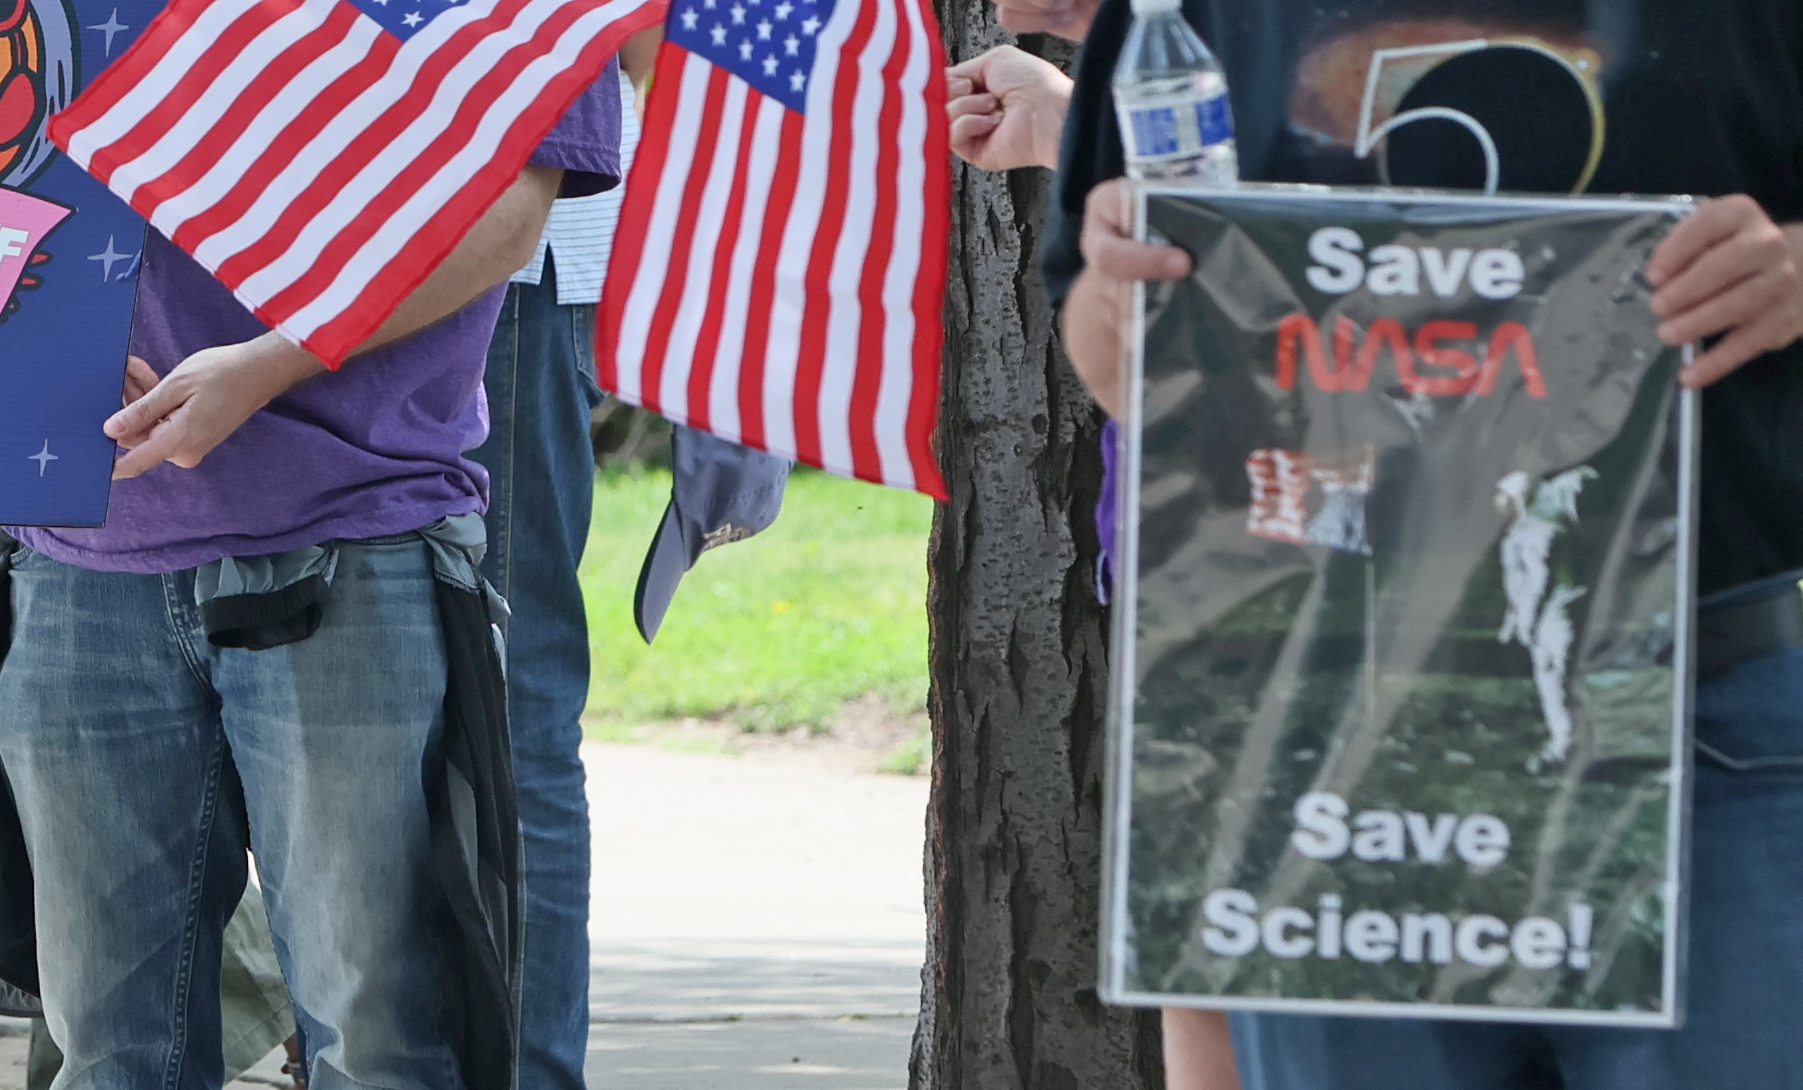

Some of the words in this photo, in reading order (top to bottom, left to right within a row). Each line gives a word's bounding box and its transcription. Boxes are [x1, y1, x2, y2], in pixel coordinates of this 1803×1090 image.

[1305, 226, 1526, 300] Save
[1274, 313, 1548, 399] NASA
[1291, 790, 1512, 868] Save
[1200, 887, 1595, 971] Science!
